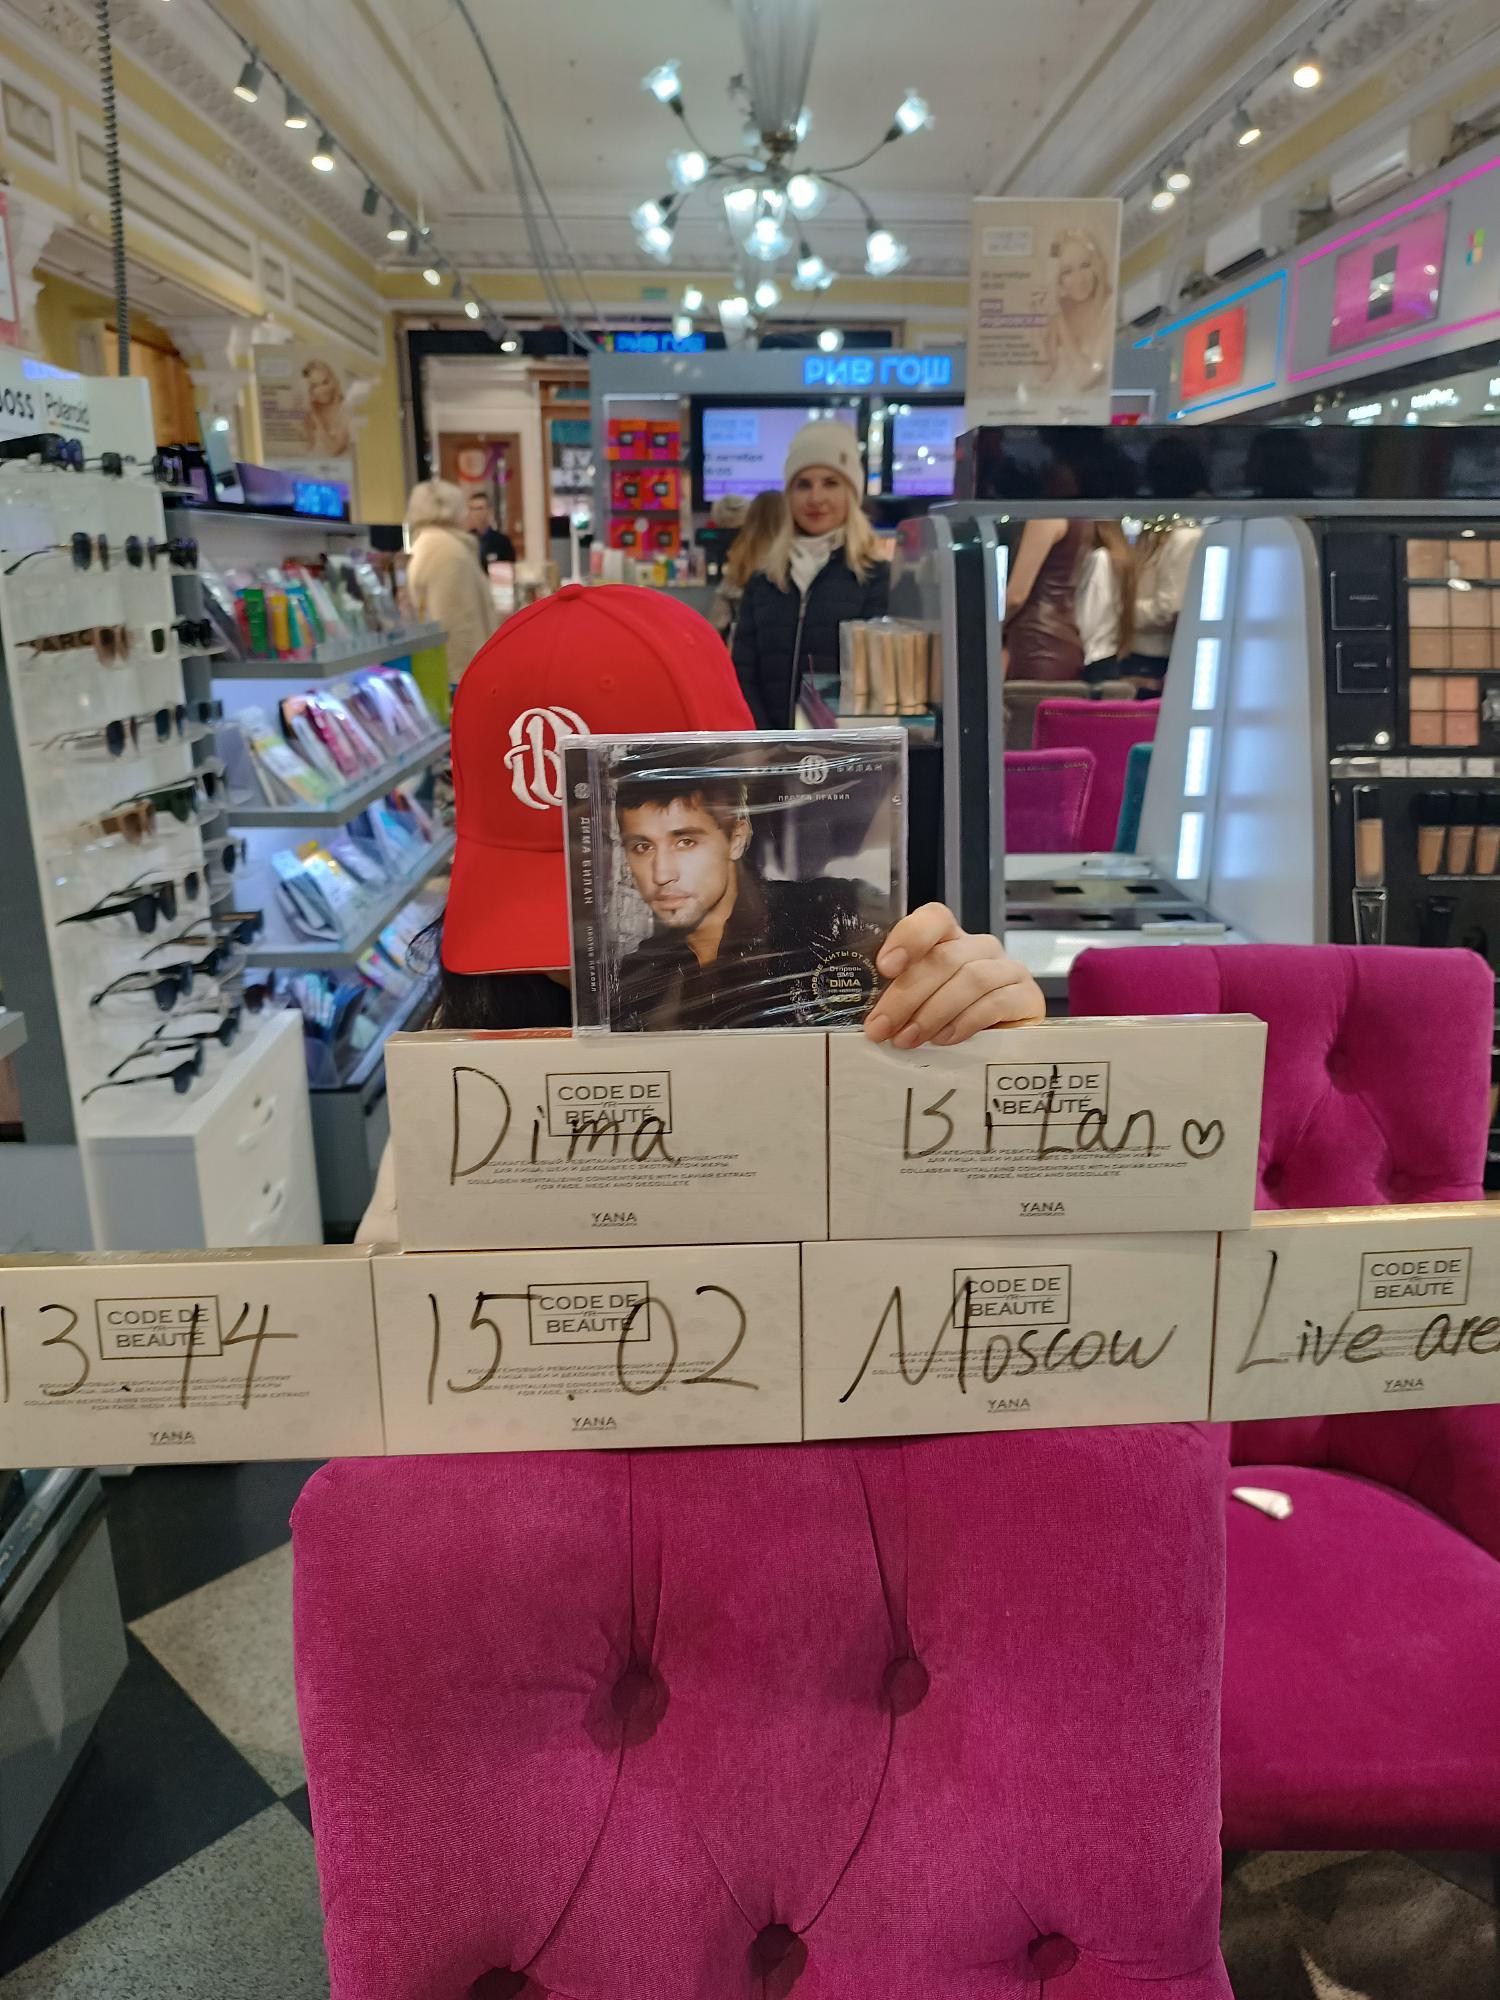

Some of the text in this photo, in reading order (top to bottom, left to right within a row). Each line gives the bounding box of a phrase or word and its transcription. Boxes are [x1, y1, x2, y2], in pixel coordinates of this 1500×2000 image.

[803, 355, 952, 386] РИВ ГОШ
[0, 388, 34, 420] OSS
[823, 950, 849, 965] ХИТЫ
[851, 951, 864, 960] ОТ
[829, 979, 862, 988] DIMA
[997, 1074, 1100, 1091] CODE DE
[558, 1084, 661, 1101] CODE DE
[1002, 1095, 1092, 1115] BEAUTÉ
[566, 1105, 655, 1125] BEAUTÉ
[451, 1066, 680, 1186] Dima
[1019, 1201, 1065, 1213] YANA
[591, 1211, 638, 1223] YANA
[1370, 1258, 1462, 1277] CODE DE
[1032, 1276, 1062, 1292] DE
[1374, 1279, 1455, 1299] BEAUTÉ
[539, 1293, 640, 1311] CODE DE
[969, 1297, 1055, 1317] BEAUTÉ
[107, 1308, 210, 1325] CODE DE
[1236, 1250, 1384, 1375] Live
[428, 1284, 760, 1405] 15.02
[838, 1275, 1178, 1403] Moscow
[1384, 1378, 1425, 1390] YANA
[987, 1398, 1031, 1410] YANA
[572, 1416, 617, 1427] YANA
[150, 1431, 195, 1442] YANA
